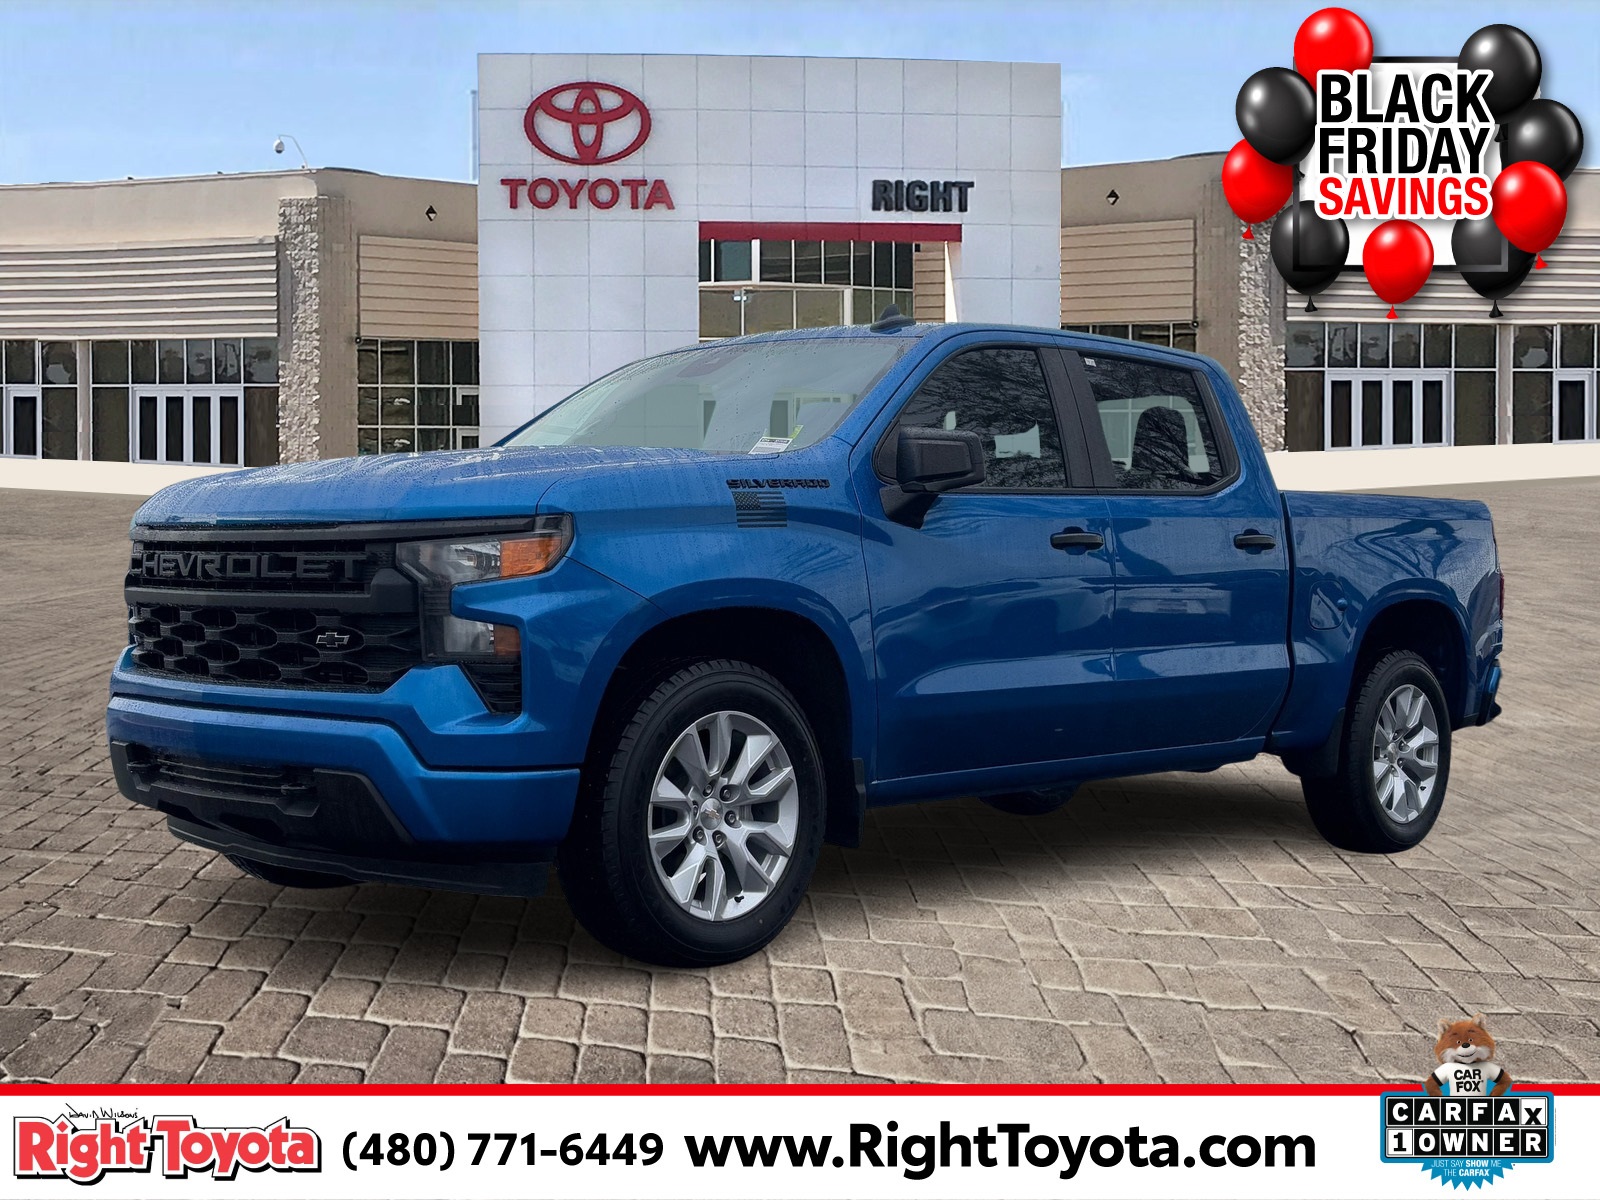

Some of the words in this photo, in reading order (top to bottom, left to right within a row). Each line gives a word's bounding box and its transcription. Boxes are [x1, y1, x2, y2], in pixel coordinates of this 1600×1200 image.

[501, 179, 674, 210] TOYOTA
[871, 179, 975, 213] RIGHT
[726, 478, 831, 490] SILVERADO
